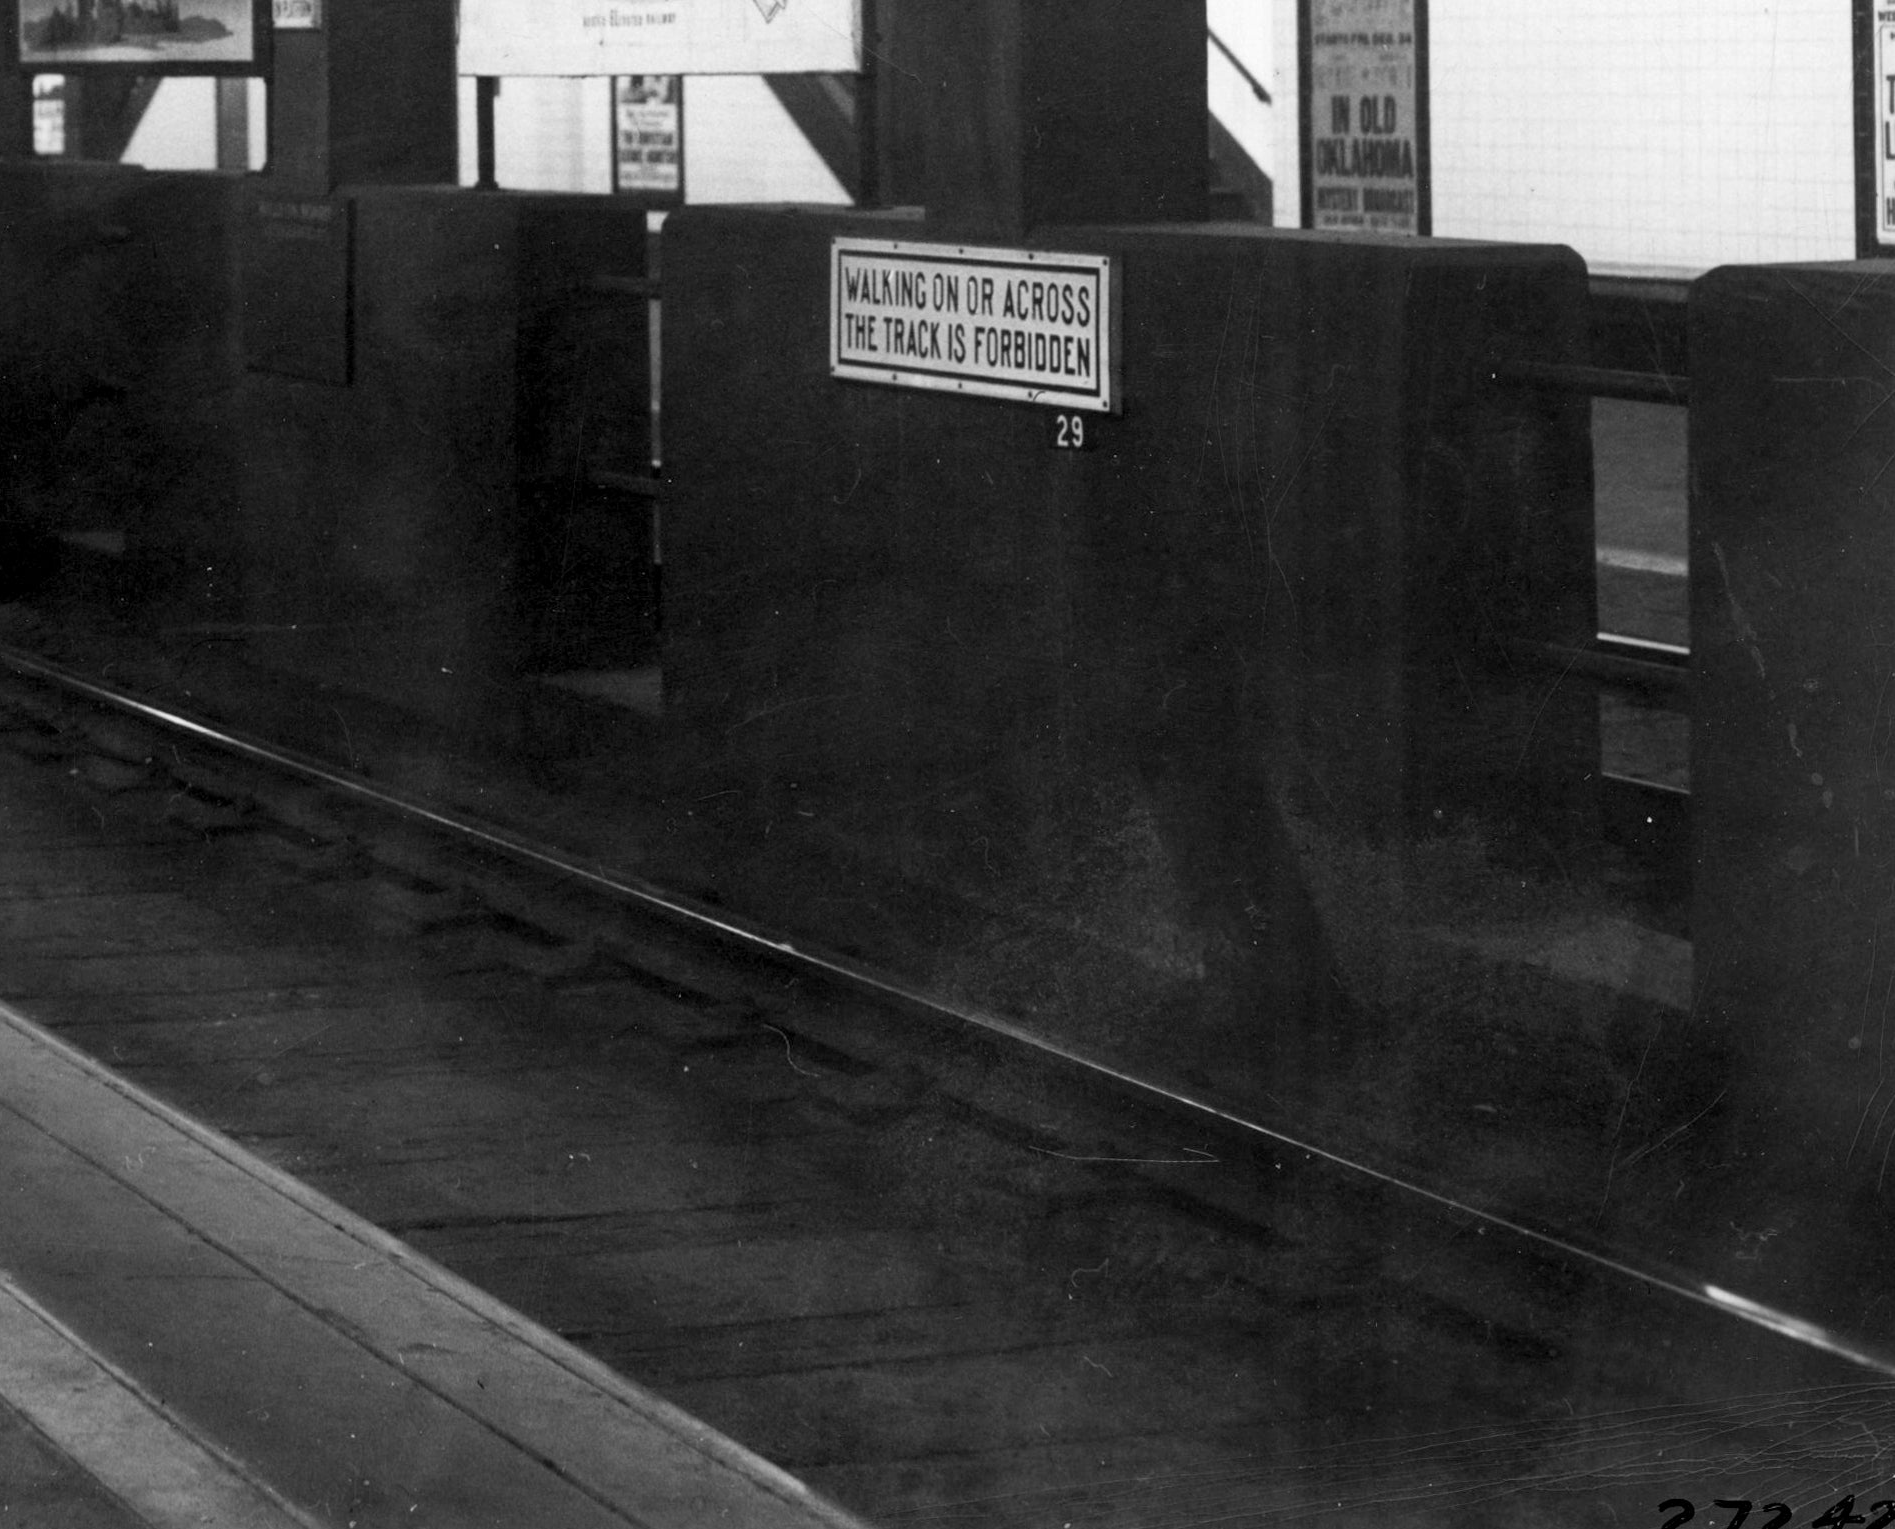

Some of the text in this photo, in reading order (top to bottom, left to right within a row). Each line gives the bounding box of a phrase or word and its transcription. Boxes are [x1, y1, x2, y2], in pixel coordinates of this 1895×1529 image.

[1331, 94, 1397, 135] IN OLD
[1317, 137, 1414, 179] OKLAHOMA
[845, 267, 1091, 328] WALKING ON OR ACROSS
[845, 313, 1091, 378] THE TRACK IS FORBIDDEN
[1056, 414, 1085, 448] 29
